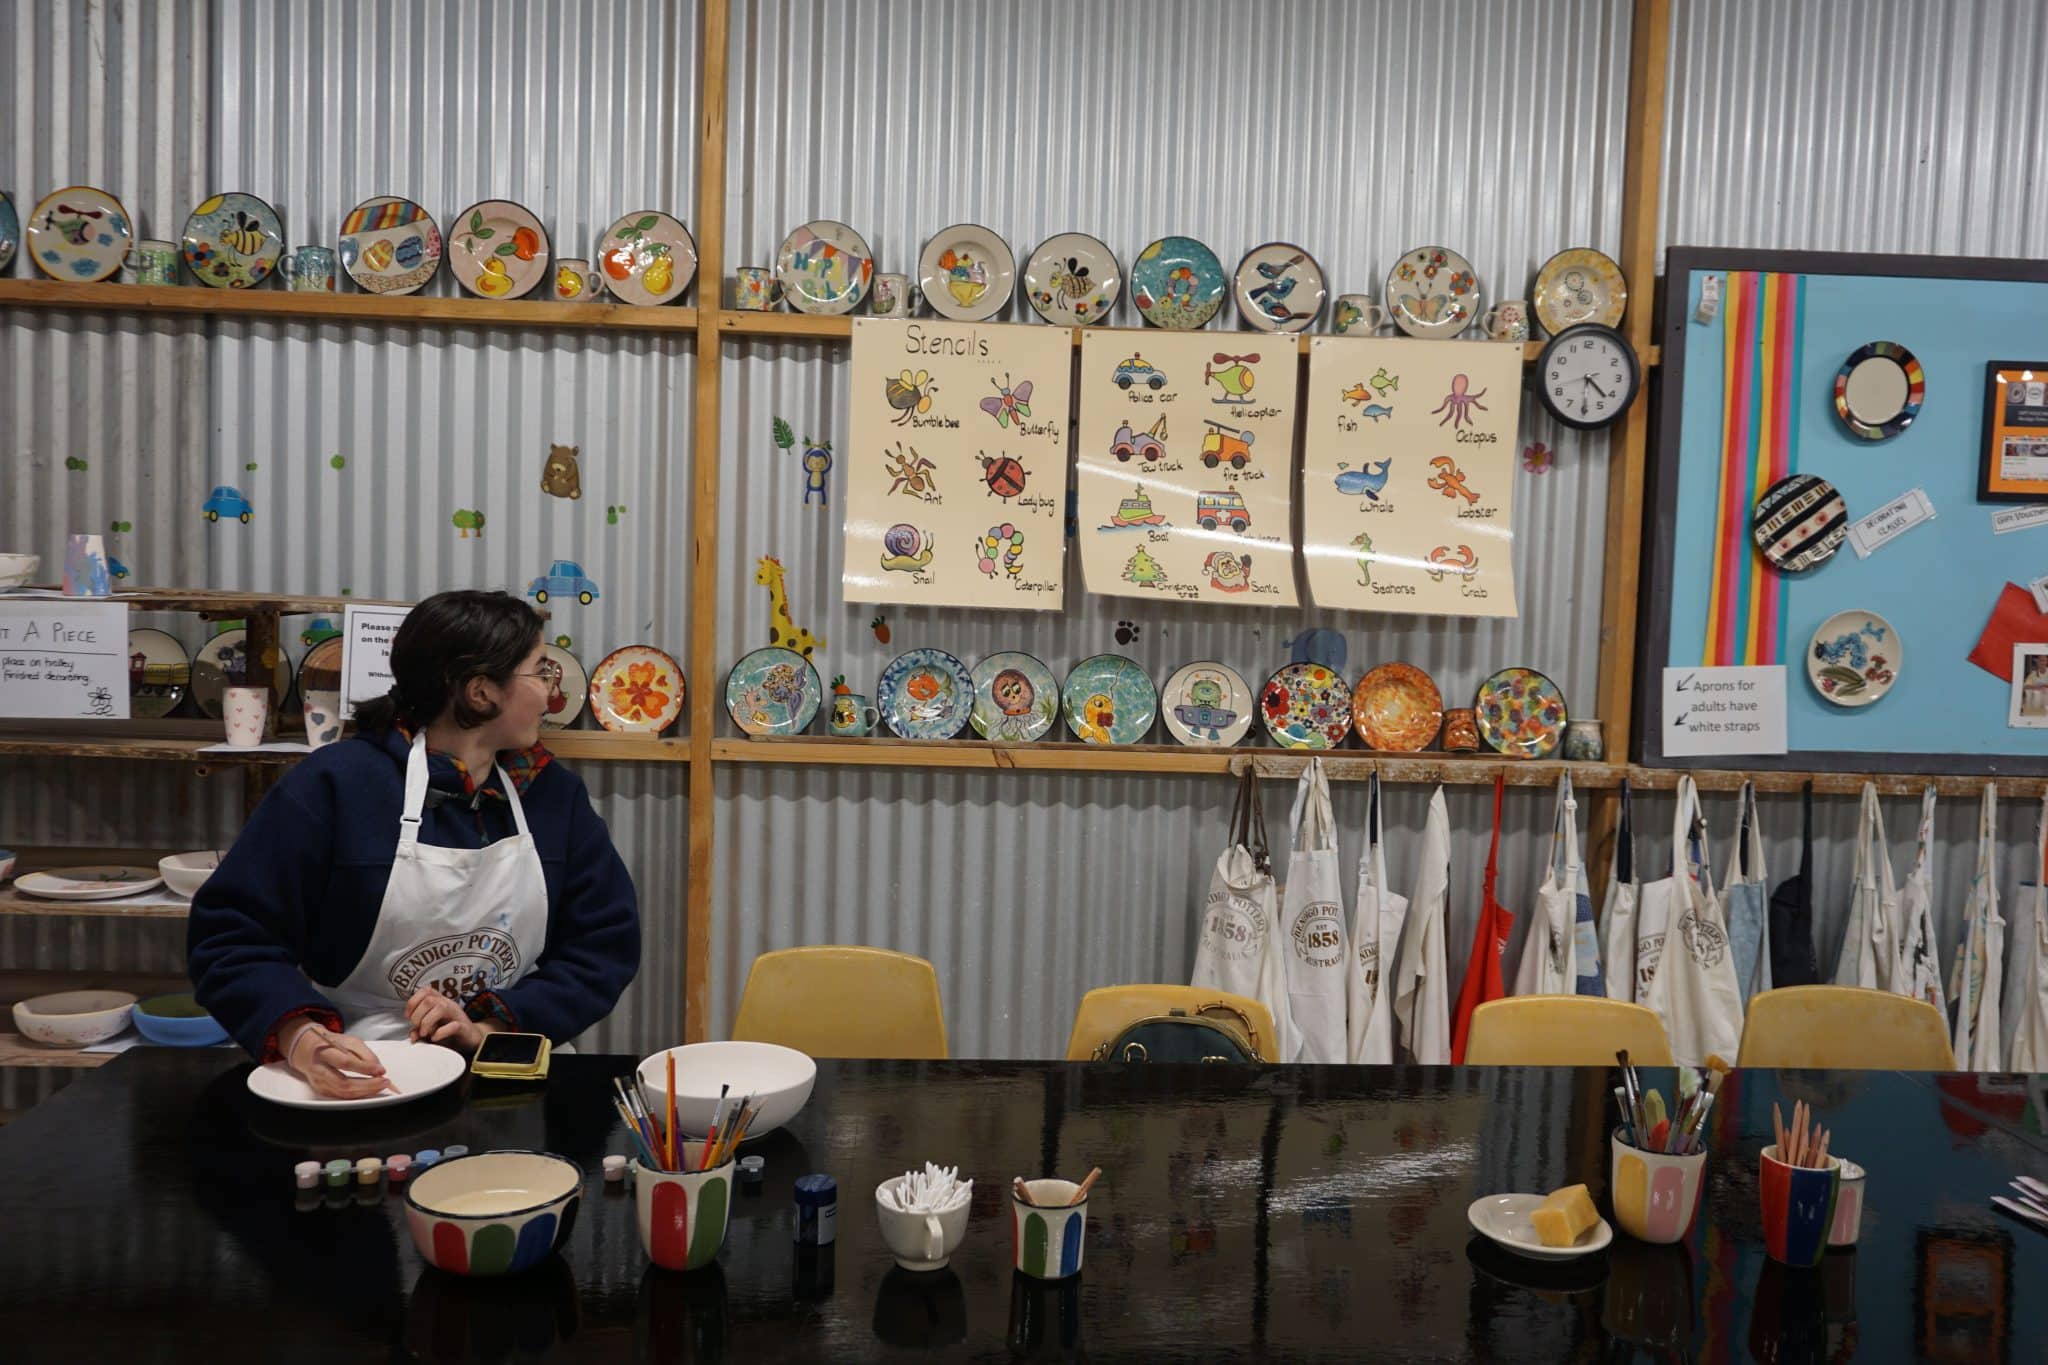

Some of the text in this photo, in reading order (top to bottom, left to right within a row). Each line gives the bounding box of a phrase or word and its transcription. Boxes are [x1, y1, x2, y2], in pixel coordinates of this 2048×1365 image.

[905, 325, 989, 357] Stencils
[1584, 340, 1594, 349] 12
[1569, 344, 1577, 353] 11
[1602, 345, 1606, 354] 1
[1557, 356, 1567, 365] 10
[1610, 358, 1618, 367] 2
[1551, 371, 1559, 380] 9
[1616, 374, 1622, 383] 3
[1555, 387, 1563, 396] 8
[1607, 390, 1616, 398] 4
[1160, 393, 1178, 402] car
[1566, 399, 1574, 408] 7
[1596, 401, 1604, 410] 5
[1020, 421, 1059, 444] Butterfly
[1456, 429, 1497, 448] Octopus
[924, 492, 943, 505] Ant
[1457, 505, 1498, 519] Lobster
[1147, 529, 1169, 542] Boat
[912, 571, 935, 585] Snail
[1014, 578, 1058, 595] Caterpillar
[1156, 582, 1199, 591] Christmas
[1250, 580, 1280, 594] Santa
[1371, 581, 1416, 595] Seahorse
[1461, 585, 1488, 598] Crab
[23, 620, 40, 643] A
[361, 623, 391, 632] Please
[374, 636, 389, 644] the
[368, 671, 393, 679] Withou
[1693, 680, 1755, 693] Aprons for
[1691, 701, 1758, 712] adults have
[1689, 722, 1761, 733] white straps
[1308, 930, 1339, 948] 1858
[393, 934, 516, 991] BENDIGO POTTERY
[453, 964, 473, 975] EST
[430, 969, 486, 1000] 1858
